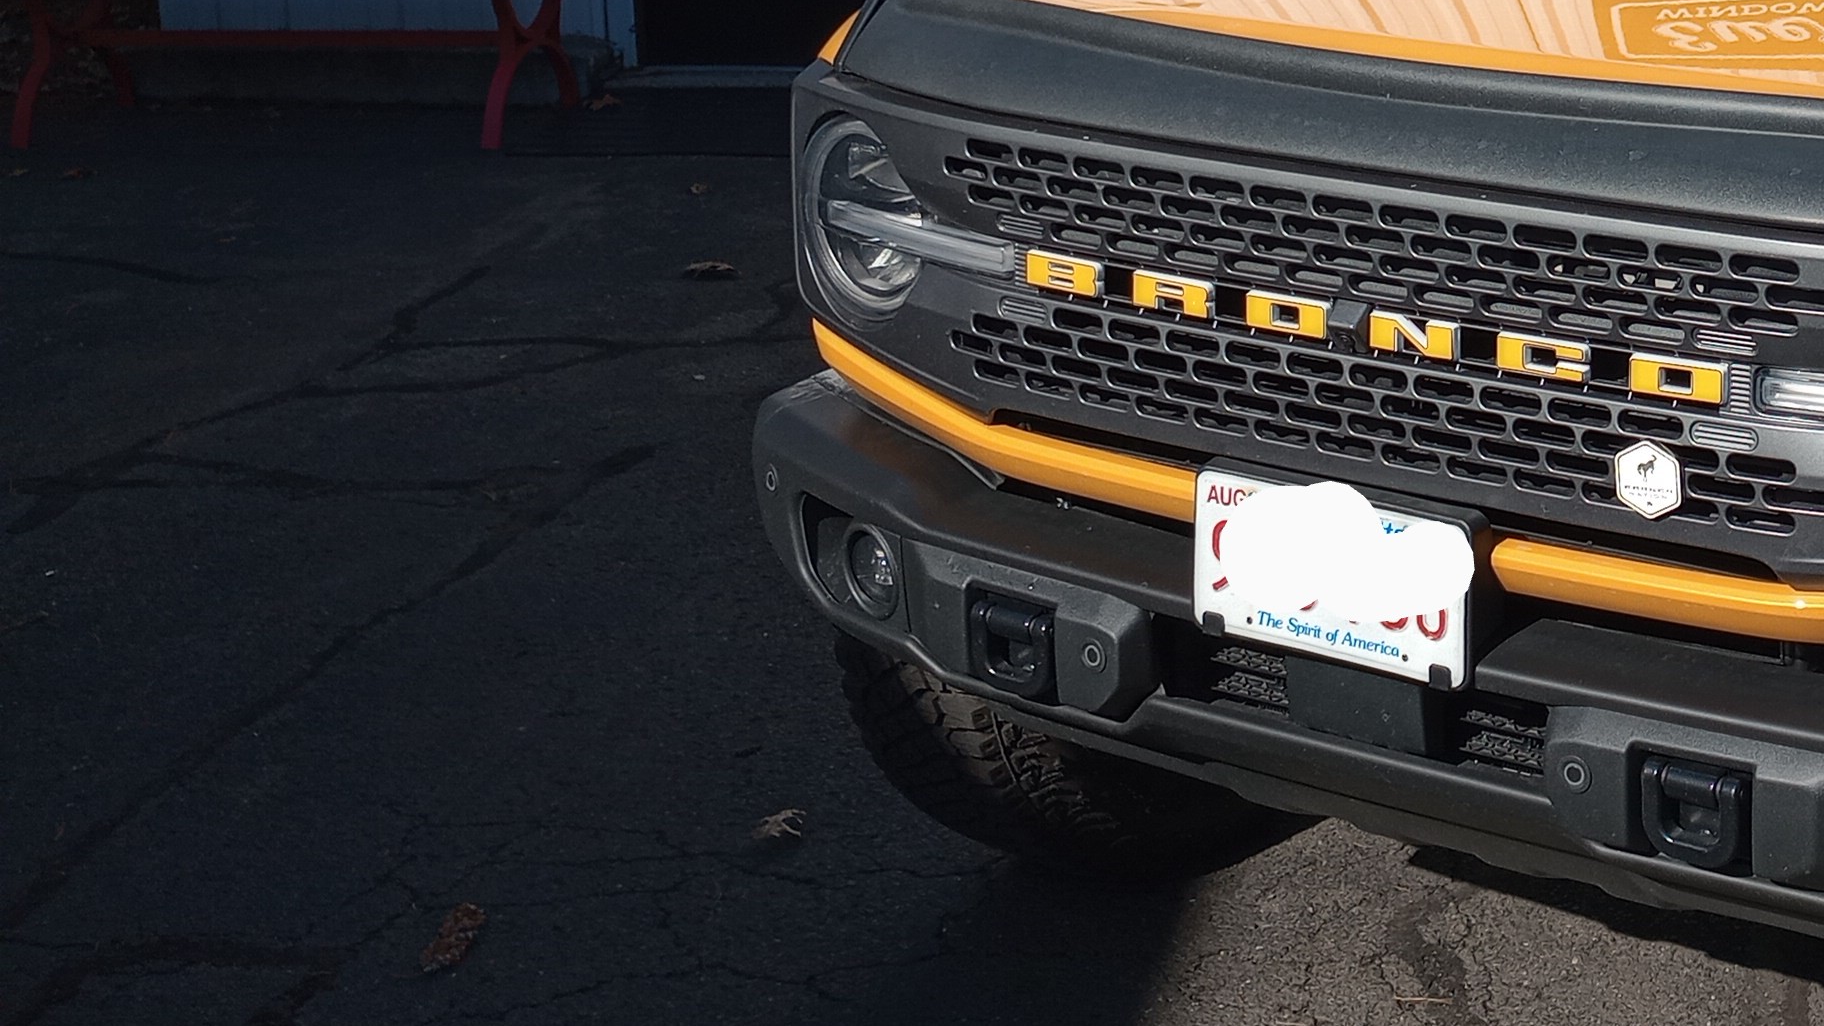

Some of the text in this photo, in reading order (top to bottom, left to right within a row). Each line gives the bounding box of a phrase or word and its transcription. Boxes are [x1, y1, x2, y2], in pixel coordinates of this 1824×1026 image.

[1025, 248, 1730, 406] BRONCO
[1258, 610, 1400, 658] The Spirit of America
